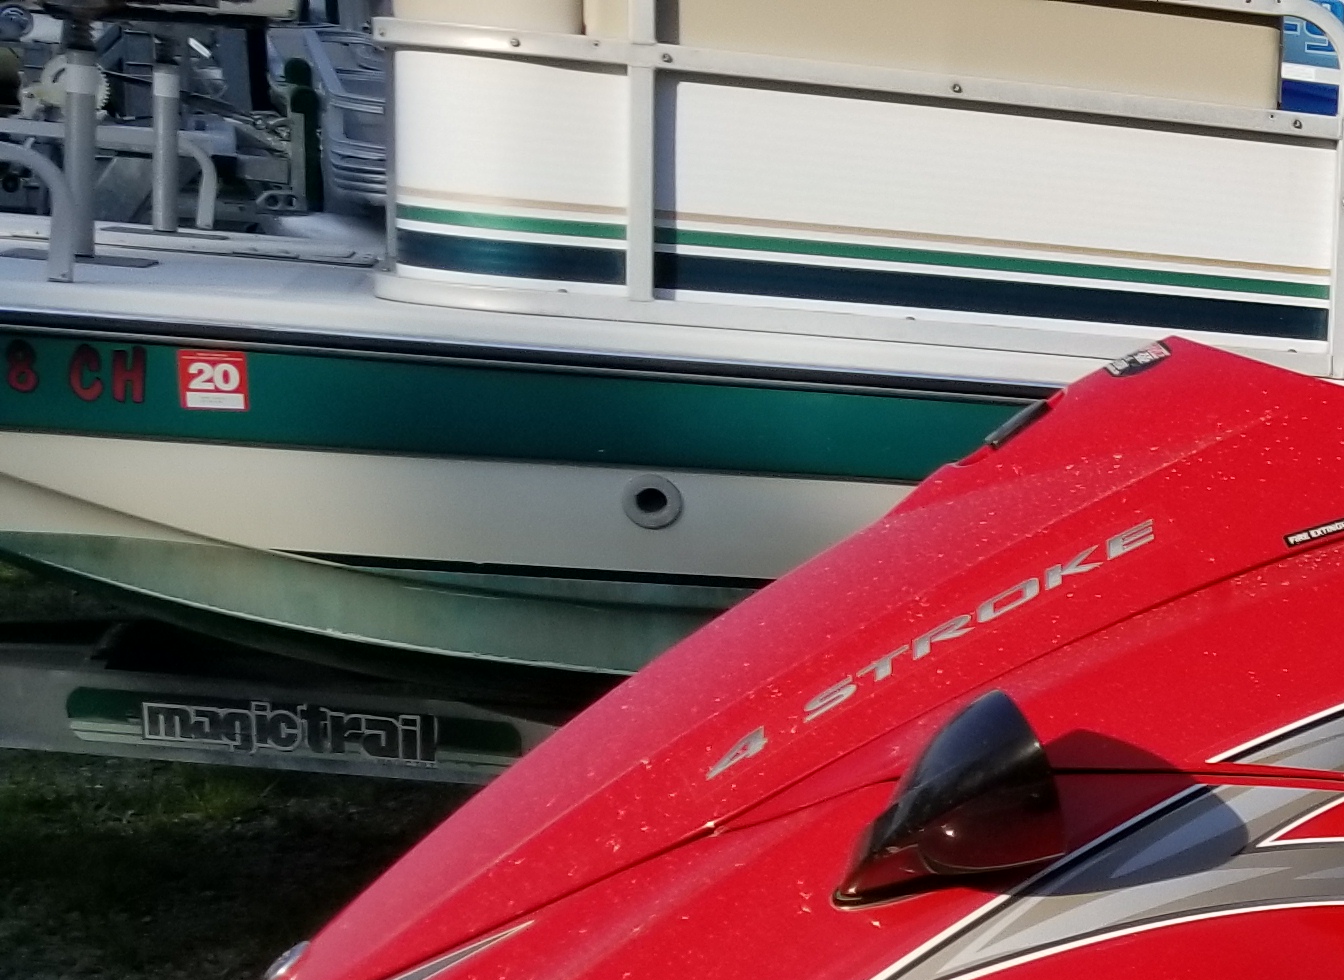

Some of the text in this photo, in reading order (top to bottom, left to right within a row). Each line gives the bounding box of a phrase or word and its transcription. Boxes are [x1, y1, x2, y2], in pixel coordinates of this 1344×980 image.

[6, 339, 147, 404] 8 CH
[188, 362, 240, 391] 20
[1287, 531, 1311, 545] FIRE
[706, 518, 1156, 780] 4 STROKE
